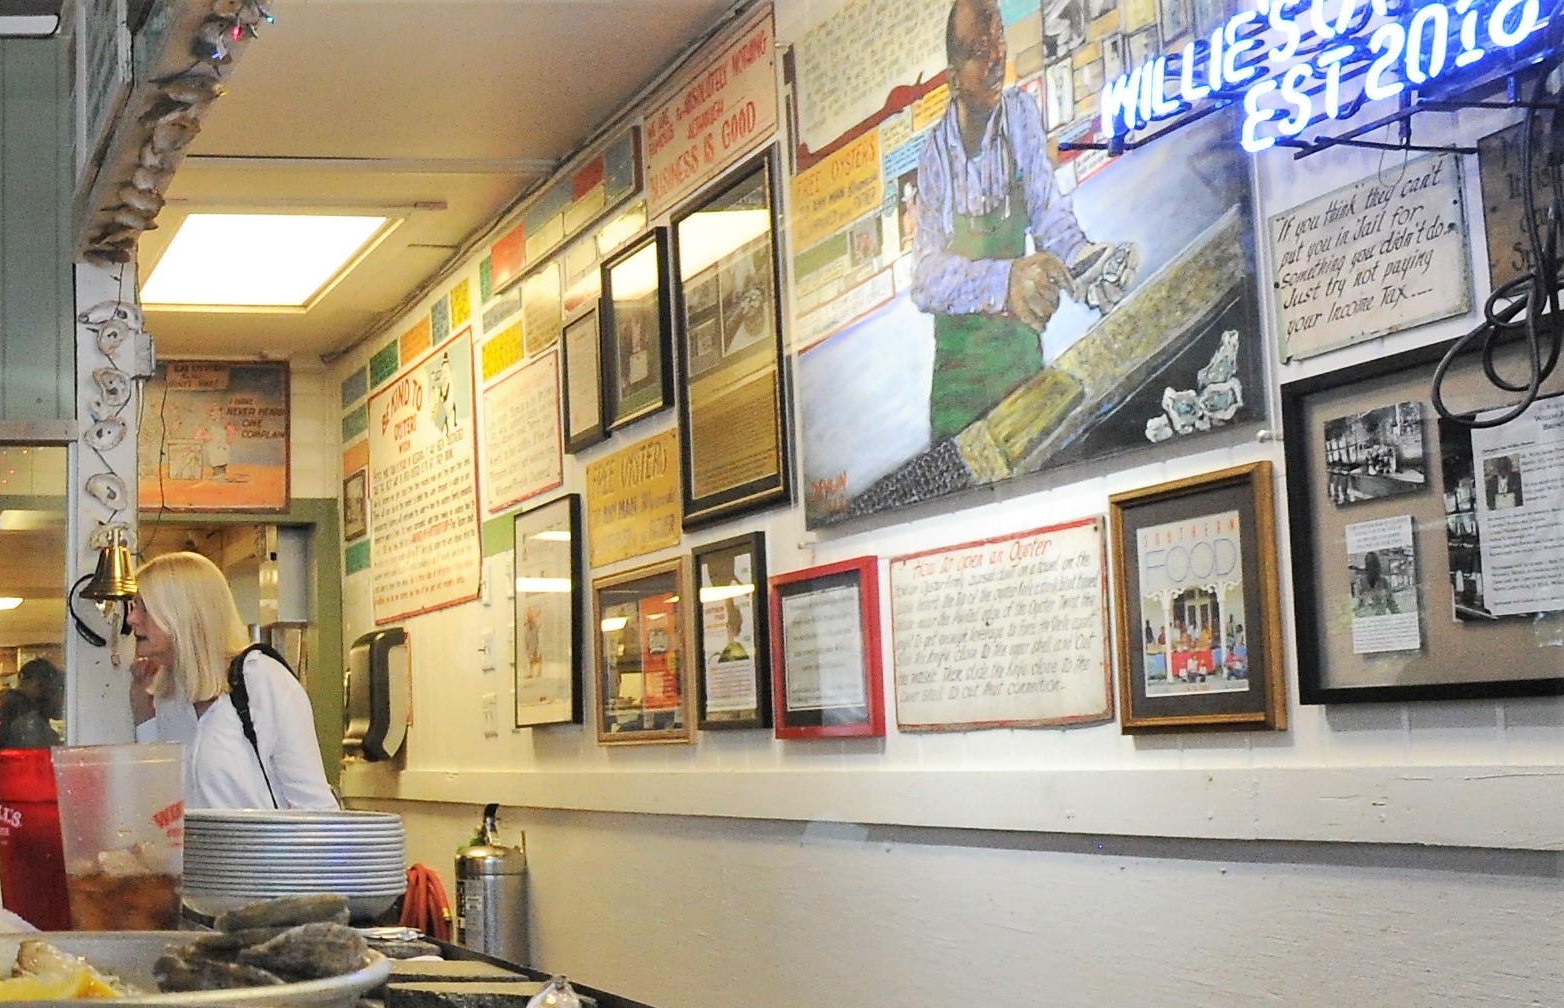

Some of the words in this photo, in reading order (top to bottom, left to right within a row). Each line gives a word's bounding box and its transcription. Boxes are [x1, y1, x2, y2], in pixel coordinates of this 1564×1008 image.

[1100, 0, 1301, 139] WILLIE'S
[1241, 44, 1355, 154] EST
[721, 101, 756, 149] GOOD
[830, 136, 875, 181] OYSTERS
[1295, 217, 1319, 242] you
[1364, 181, 1394, 214] they
[1400, 160, 1444, 198] can't
[1278, 245, 1301, 275] put
[1307, 239, 1331, 261] you
[1336, 230, 1349, 245] in
[1353, 212, 1385, 241] Jail
[1390, 204, 1424, 227] for
[1281, 255, 1344, 289] something
[1351, 243, 1376, 270] you
[1379, 220, 1423, 256] didn't
[1283, 284, 1321, 310] Just
[1325, 276, 1346, 304] try
[1354, 265, 1376, 285] not
[1384, 249, 1435, 281] paying
[1286, 309, 1323, 344] your
[1327, 294, 1374, 323] Income
[227, 407, 256, 416] NEVER
[390, 378, 410, 418] KIND
[412, 378, 422, 412] TO
[1144, 517, 1236, 548] SOUTHERN
[913, 559, 935, 579] How
[956, 551, 983, 572] open
[1009, 536, 1053, 568] Oyster
[1076, 552, 1091, 568] the
[1146, 538, 1236, 586] FOOD
